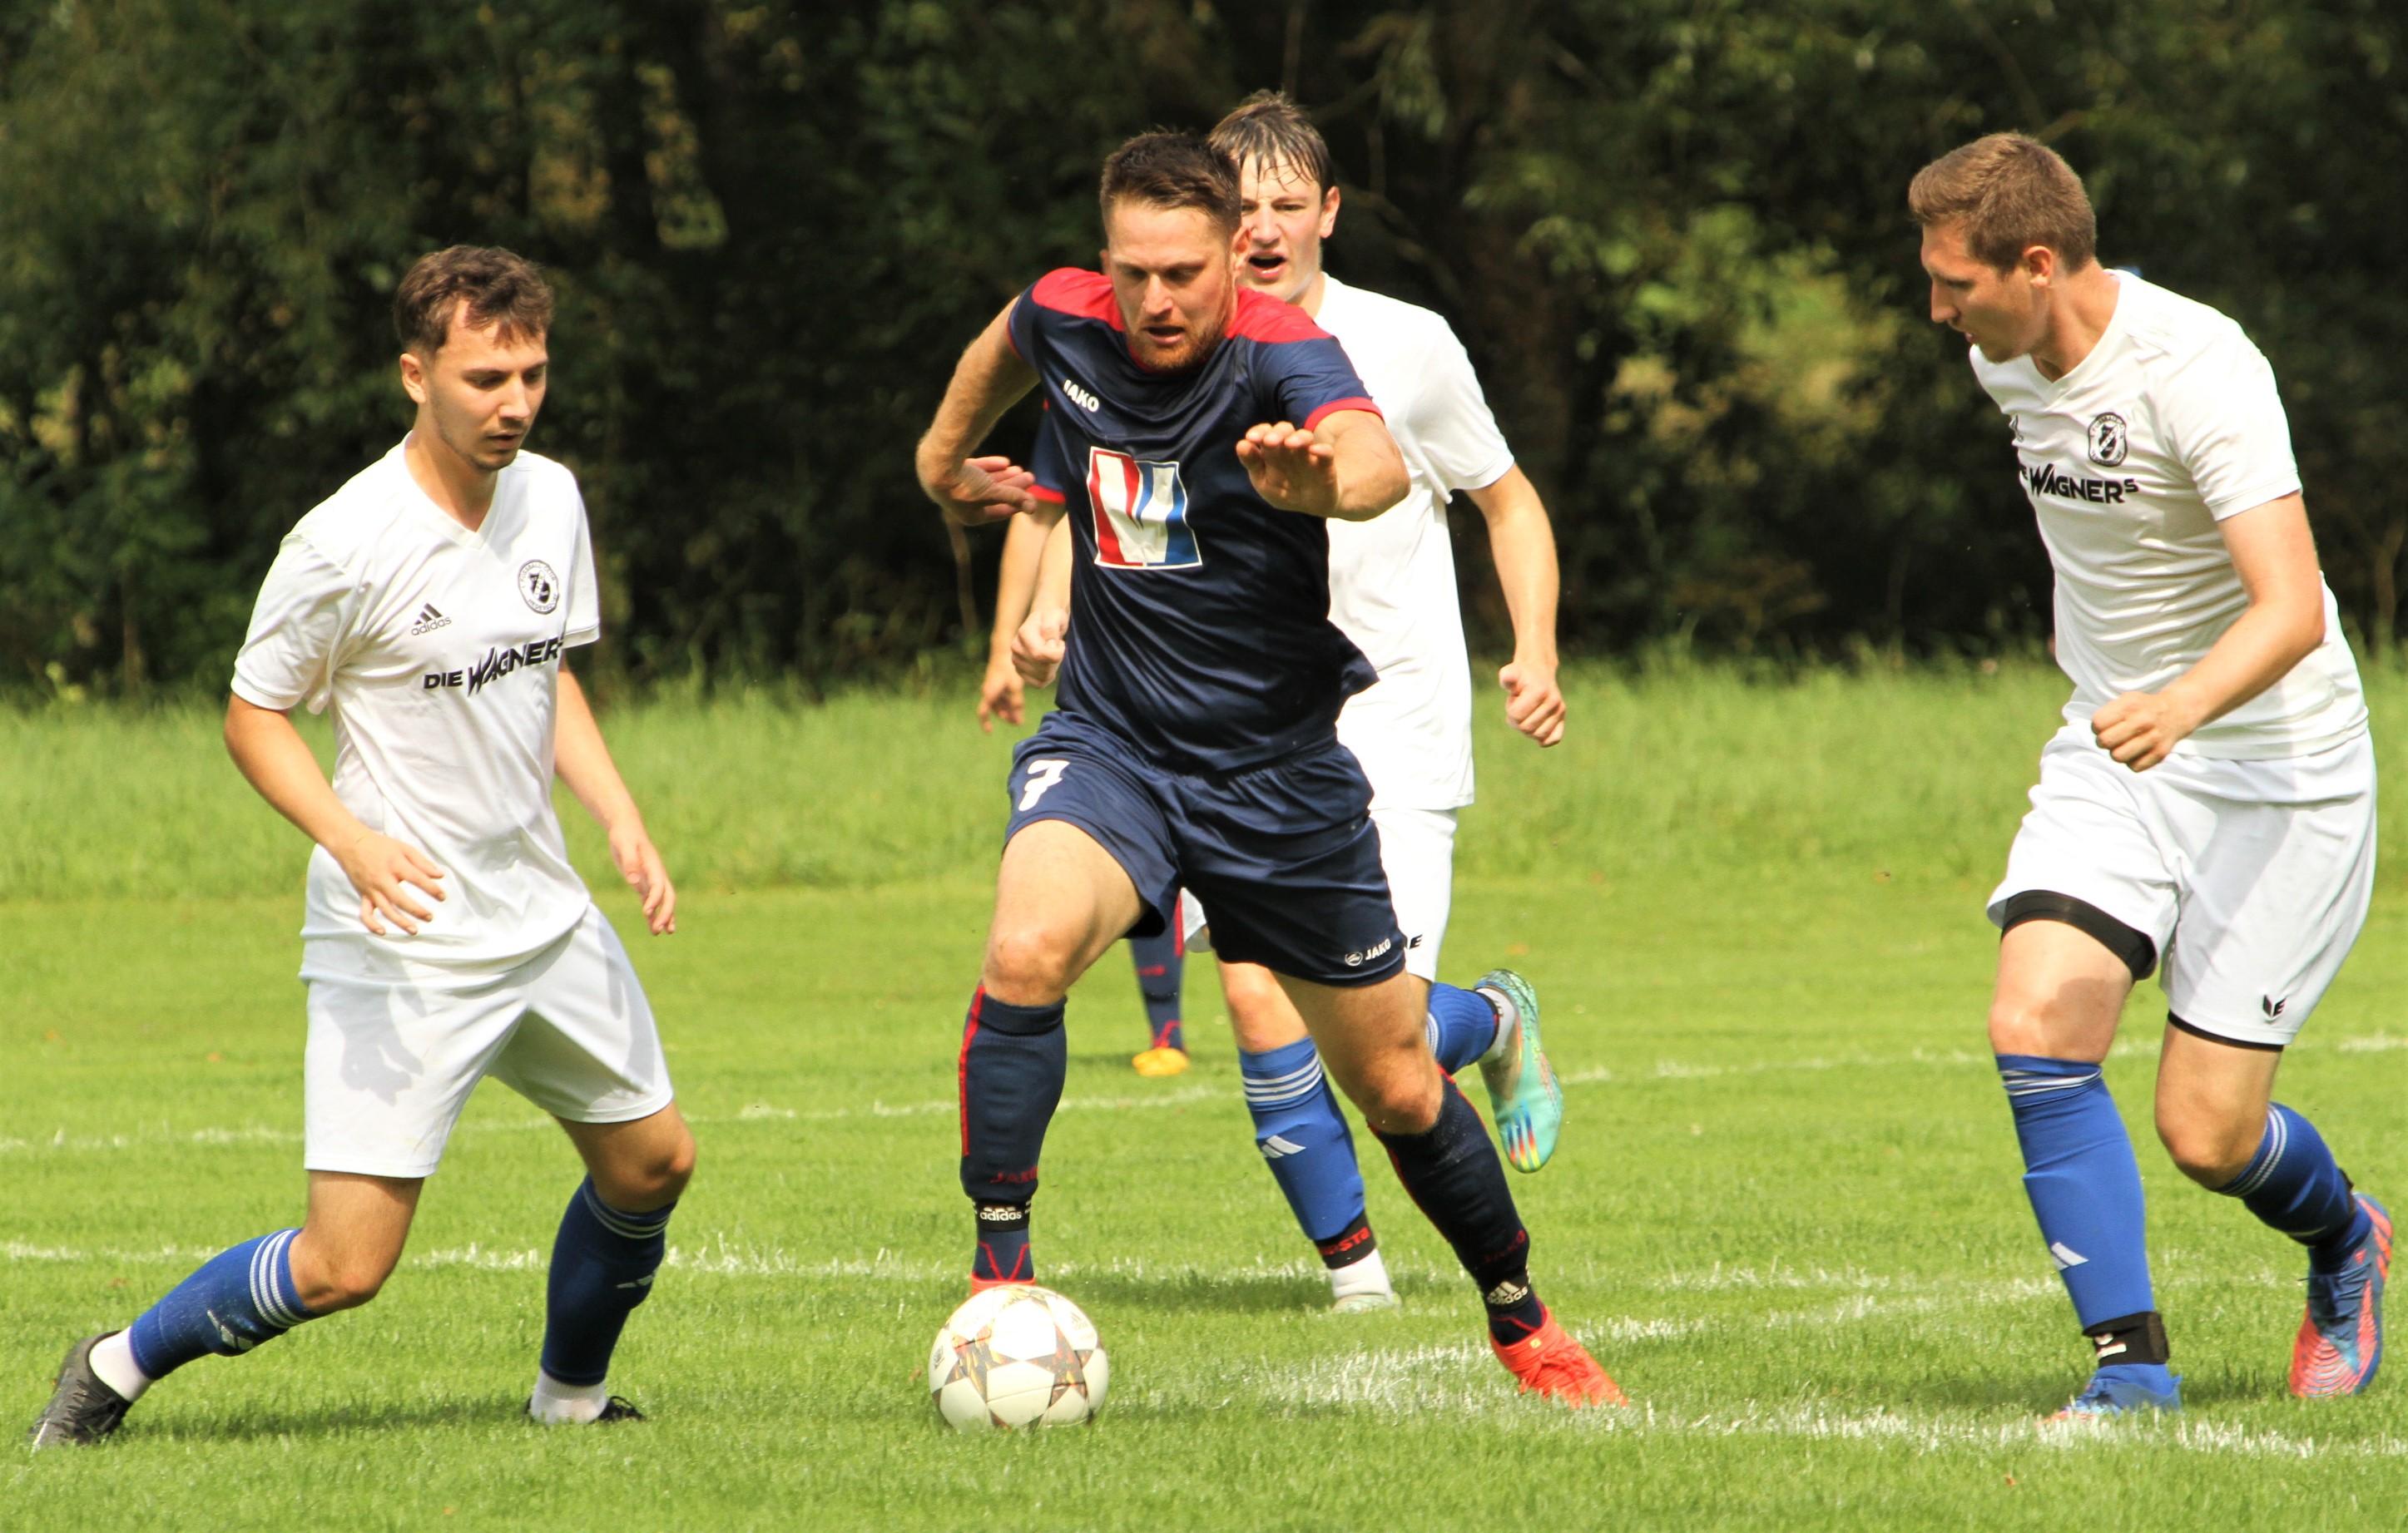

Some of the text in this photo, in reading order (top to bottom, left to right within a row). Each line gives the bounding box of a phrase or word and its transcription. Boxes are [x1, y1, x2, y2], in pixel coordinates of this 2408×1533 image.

[2029, 462, 2139, 504] WAGNERS
[411, 616, 453, 636] adidas
[423, 635, 563, 698] DIE WAGNER
[1018, 758, 1072, 812] 7
[1365, 937, 1392, 961] JAKO
[979, 1210, 1023, 1222] adidas
